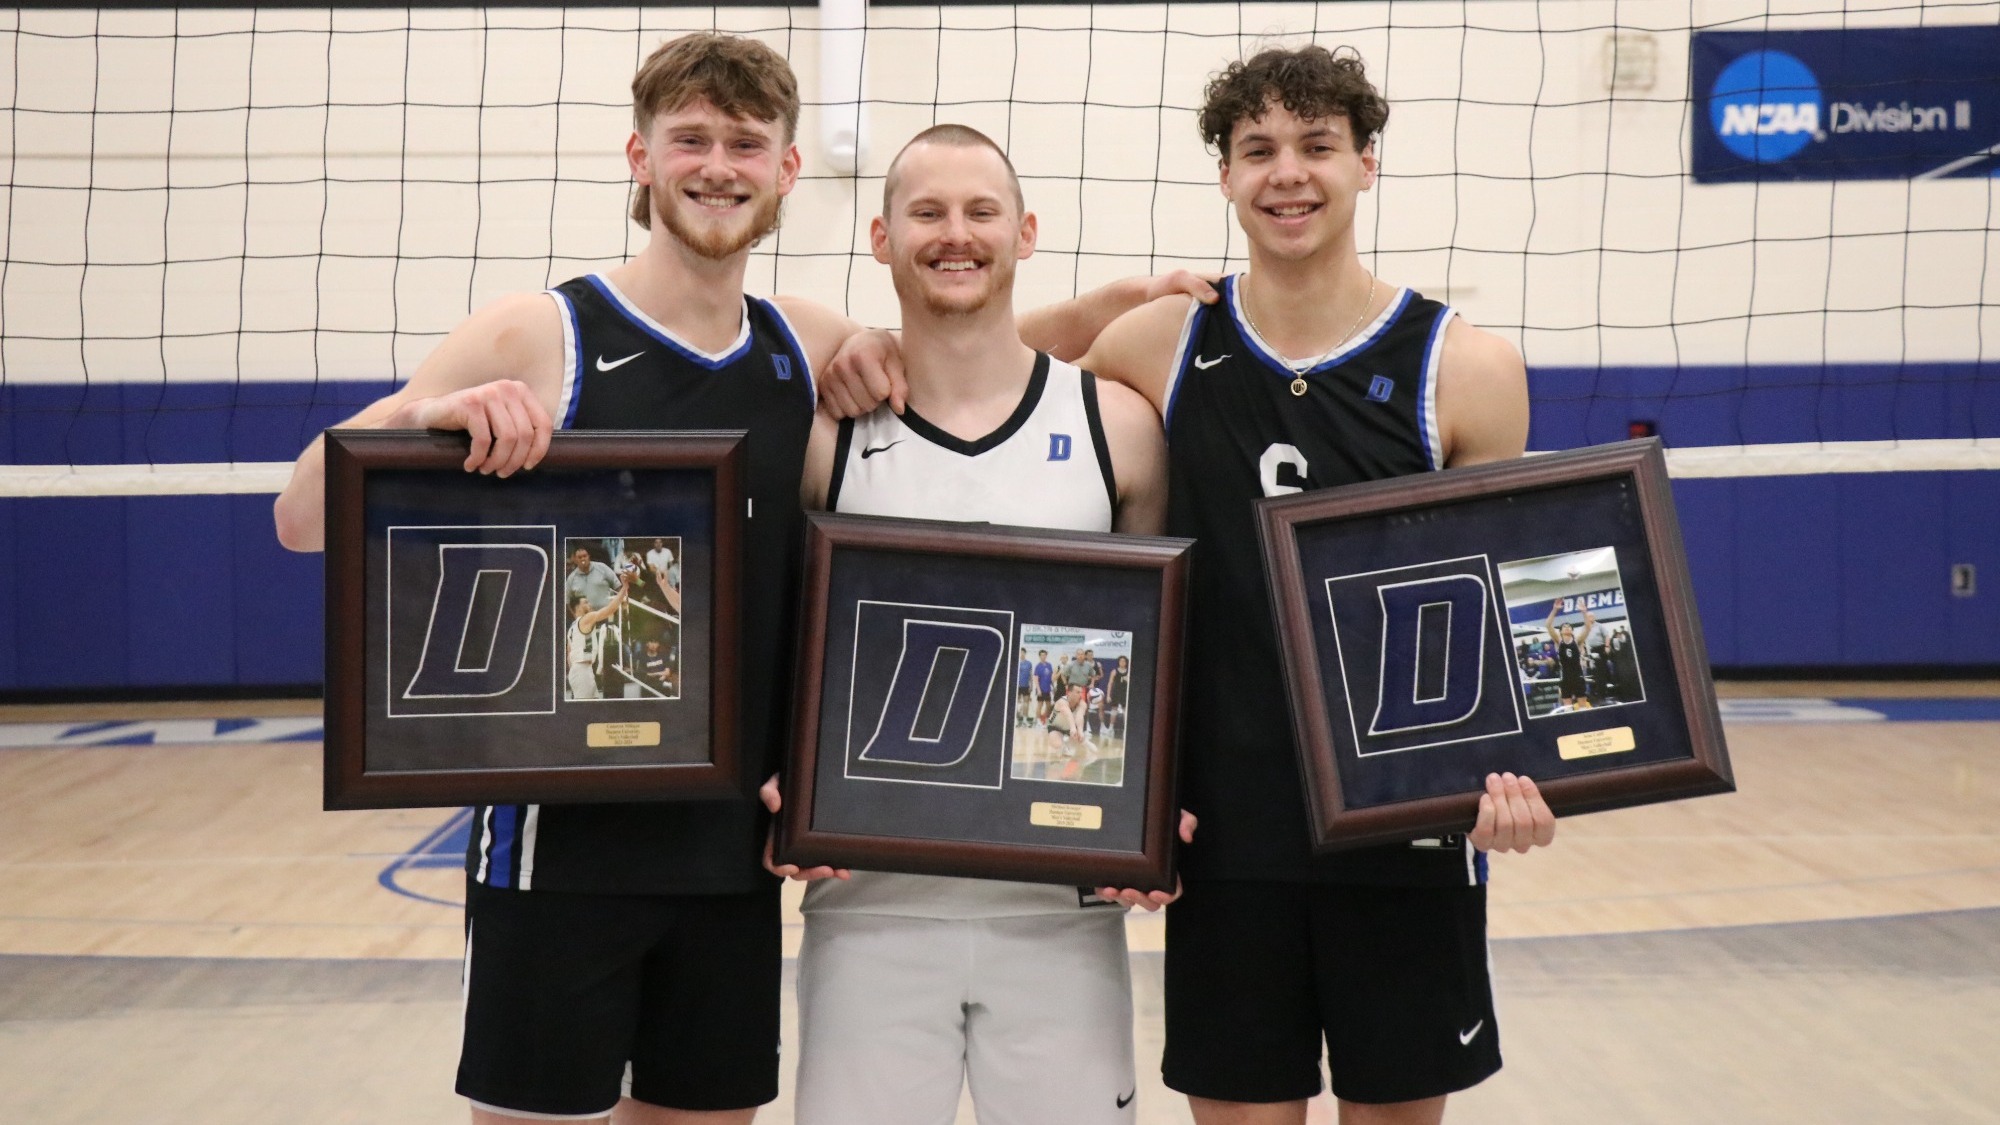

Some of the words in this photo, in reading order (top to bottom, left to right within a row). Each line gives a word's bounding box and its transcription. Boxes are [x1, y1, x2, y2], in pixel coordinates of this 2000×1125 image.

[1720, 102, 1819, 136] NCAA
[1830, 101, 1948, 133] Division
[771, 353, 792, 380] D
[1366, 374, 1394, 402] D
[1047, 433, 1072, 462] D
[402, 543, 549, 700] D
[1367, 573, 1488, 736] D
[858, 618, 1005, 767] D
